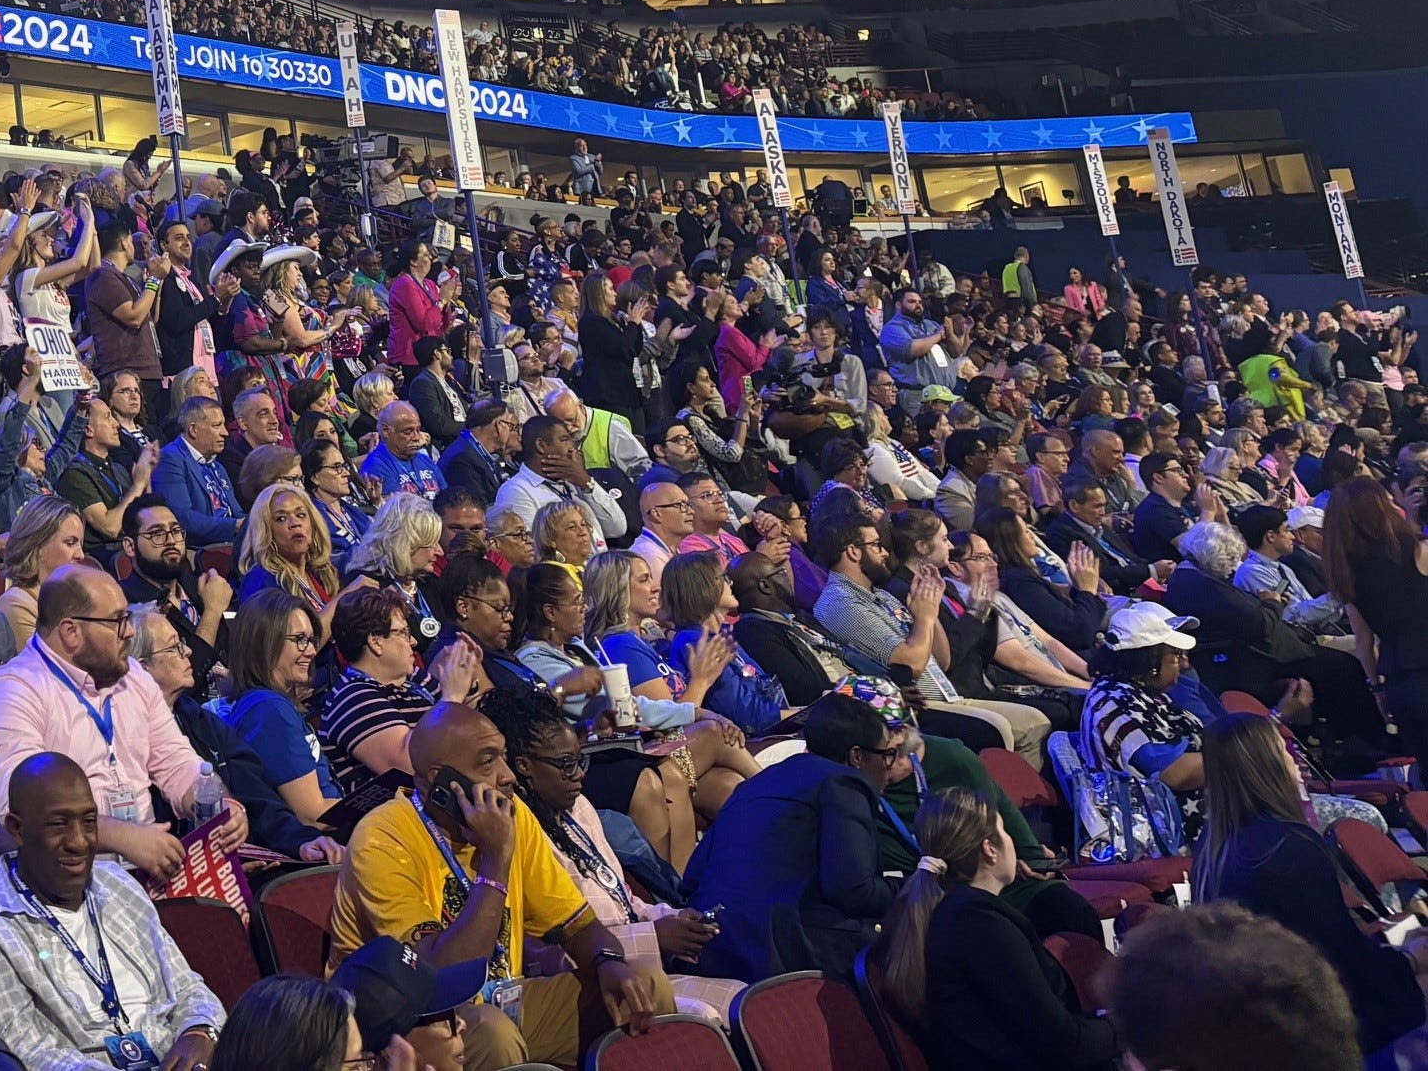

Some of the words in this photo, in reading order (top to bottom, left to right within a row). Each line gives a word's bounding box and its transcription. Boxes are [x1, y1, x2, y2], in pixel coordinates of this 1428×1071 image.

[2, 12, 93, 55] 2024
[447, 29, 460, 61] NEW
[184, 44, 236, 73] JOIN
[242, 55, 264, 75] to
[266, 57, 332, 87] 30330
[340, 34, 361, 112] UTAH
[385, 71, 447, 109] DNC
[470, 84, 529, 121] 2024
[452, 66, 473, 163] HAMPSHIRE
[760, 102, 786, 189] ALASKA
[888, 116, 908, 198] VERMONT
[1088, 154, 1111, 222] MISSOURI
[1156, 142, 1173, 187] NORTH
[1167, 191, 1187, 246] DAKOTA
[1328, 192, 1354, 265] MONTANA
[33, 327, 72, 355] OHIO
[43, 368, 81, 379] HARRIS
[52, 377, 81, 387] WALZ
[188, 839, 208, 880] OUR
